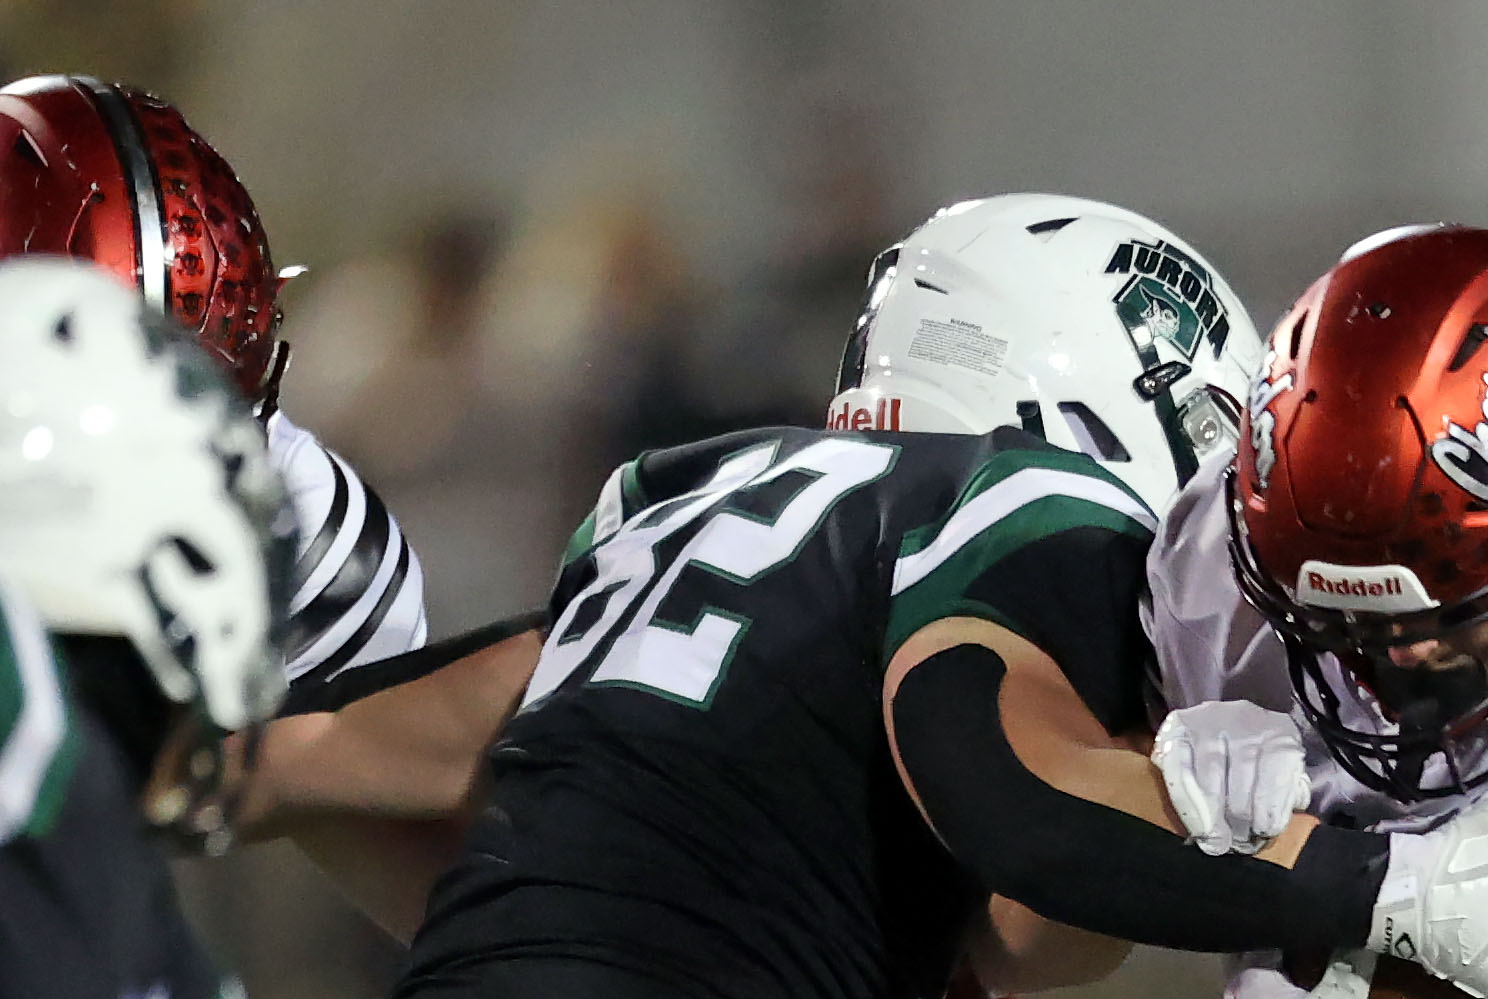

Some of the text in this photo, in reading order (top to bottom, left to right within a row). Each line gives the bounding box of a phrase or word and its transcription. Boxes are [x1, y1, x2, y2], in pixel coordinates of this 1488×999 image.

[1103, 241, 1230, 361] AURORA
[516, 436, 903, 712] 82
[1308, 571, 1402, 597] Riddell
